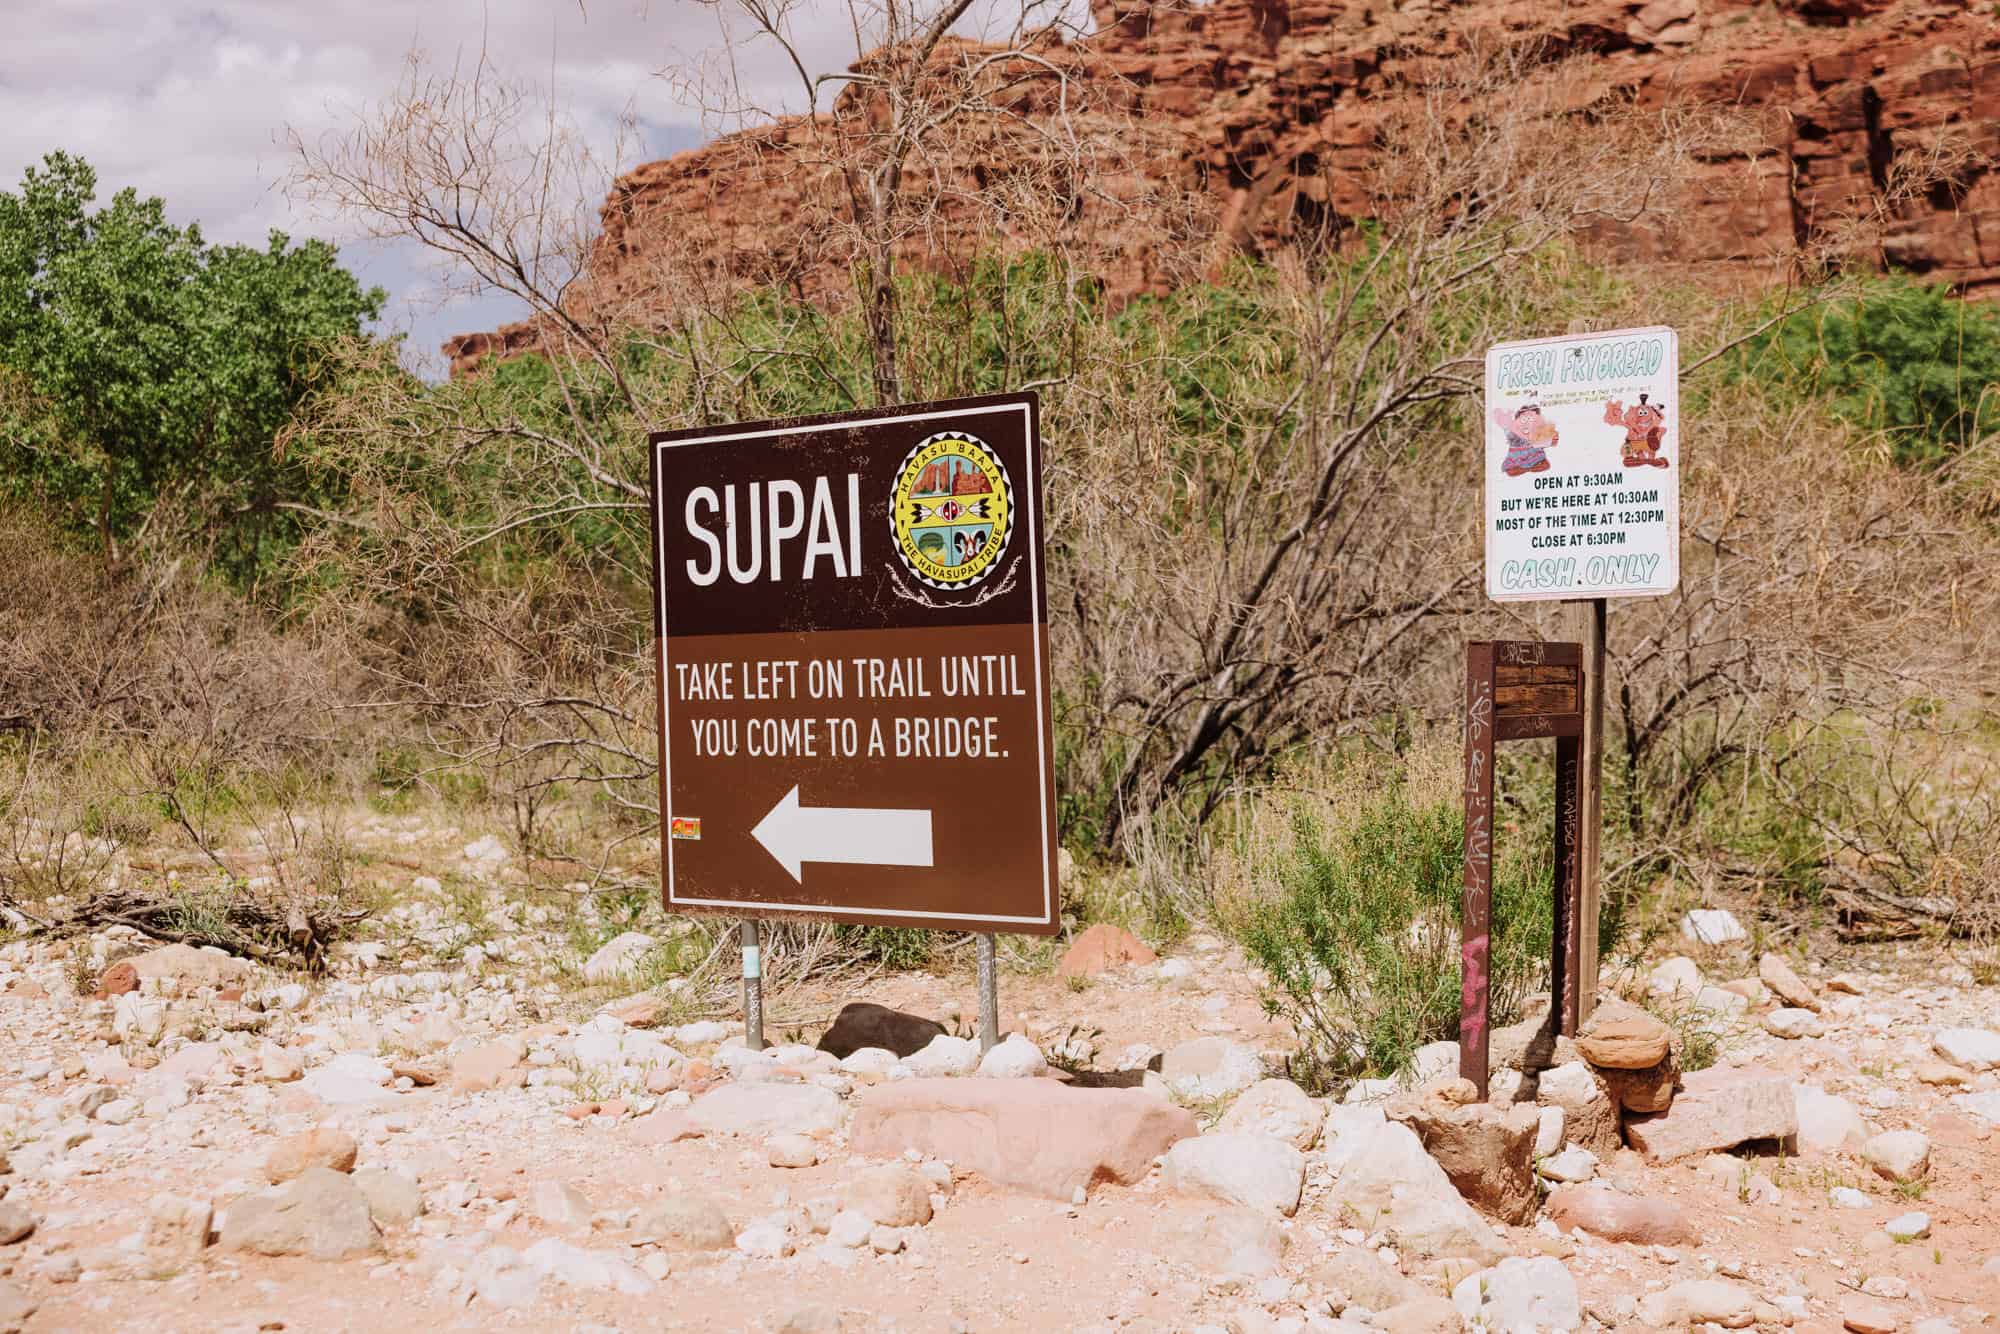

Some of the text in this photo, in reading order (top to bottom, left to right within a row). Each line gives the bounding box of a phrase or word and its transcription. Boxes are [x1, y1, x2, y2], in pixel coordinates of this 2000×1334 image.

[1497, 338, 1663, 389] FRESH FRYBREAD
[901, 444, 947, 493] HAVASU
[1534, 473, 1623, 490] OPEN AT 9:30AM
[1496, 510, 1664, 531] MOST OF THE TIME AT 12:30PM
[1501, 490, 1658, 511] BUT WE'RE HERE AT 10:30AM
[685, 473, 862, 587] SUPAI
[1532, 532, 1625, 548] CLOSE AT 6:30PM
[902, 529, 1003, 579] THE HAVASUPAI TRIBE
[1501, 553, 1660, 590] CASH ONLY
[676, 655, 1025, 700] TAKE LEFT ON TRAIL UNTIL
[691, 717, 1009, 757] YOU COME TO A BRIDGE.
